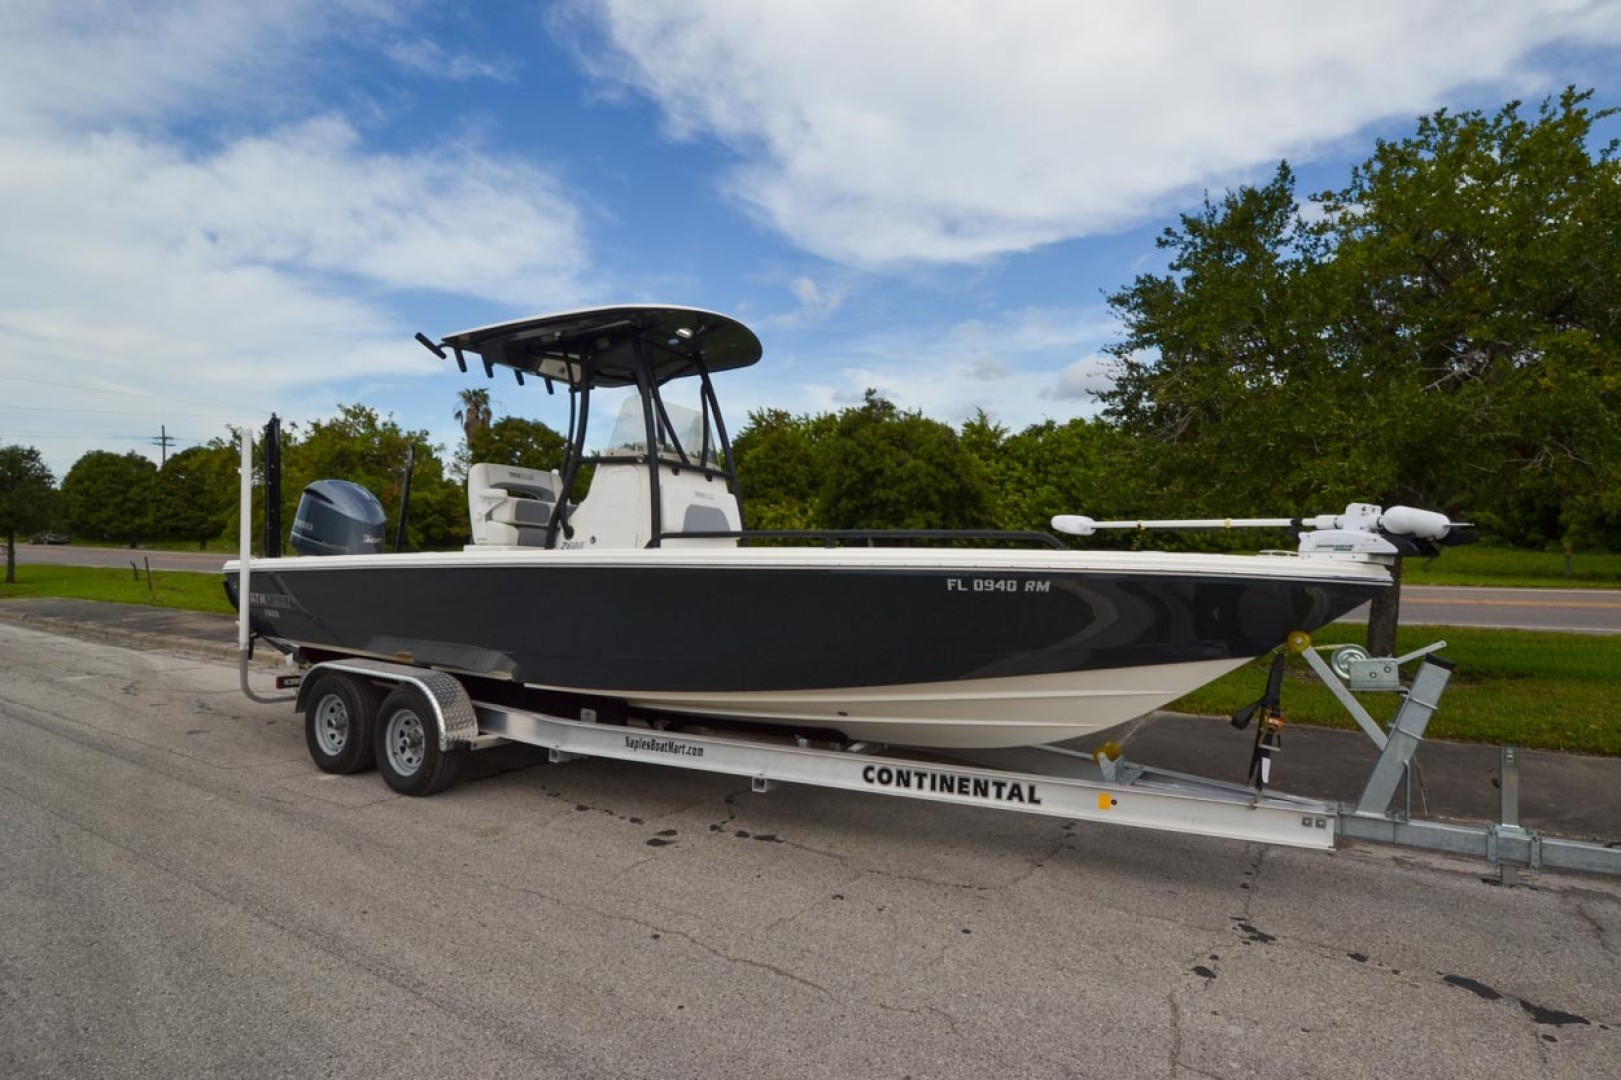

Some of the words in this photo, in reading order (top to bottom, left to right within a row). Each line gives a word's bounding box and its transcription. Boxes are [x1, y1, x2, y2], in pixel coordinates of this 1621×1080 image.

[947, 578, 968, 591] FL
[973, 579, 1018, 592] 0940
[1024, 580, 1050, 592] RM
[625, 735, 704, 758] NaplesBoatMart.com
[862, 765, 1042, 805] CONTINENTAL
